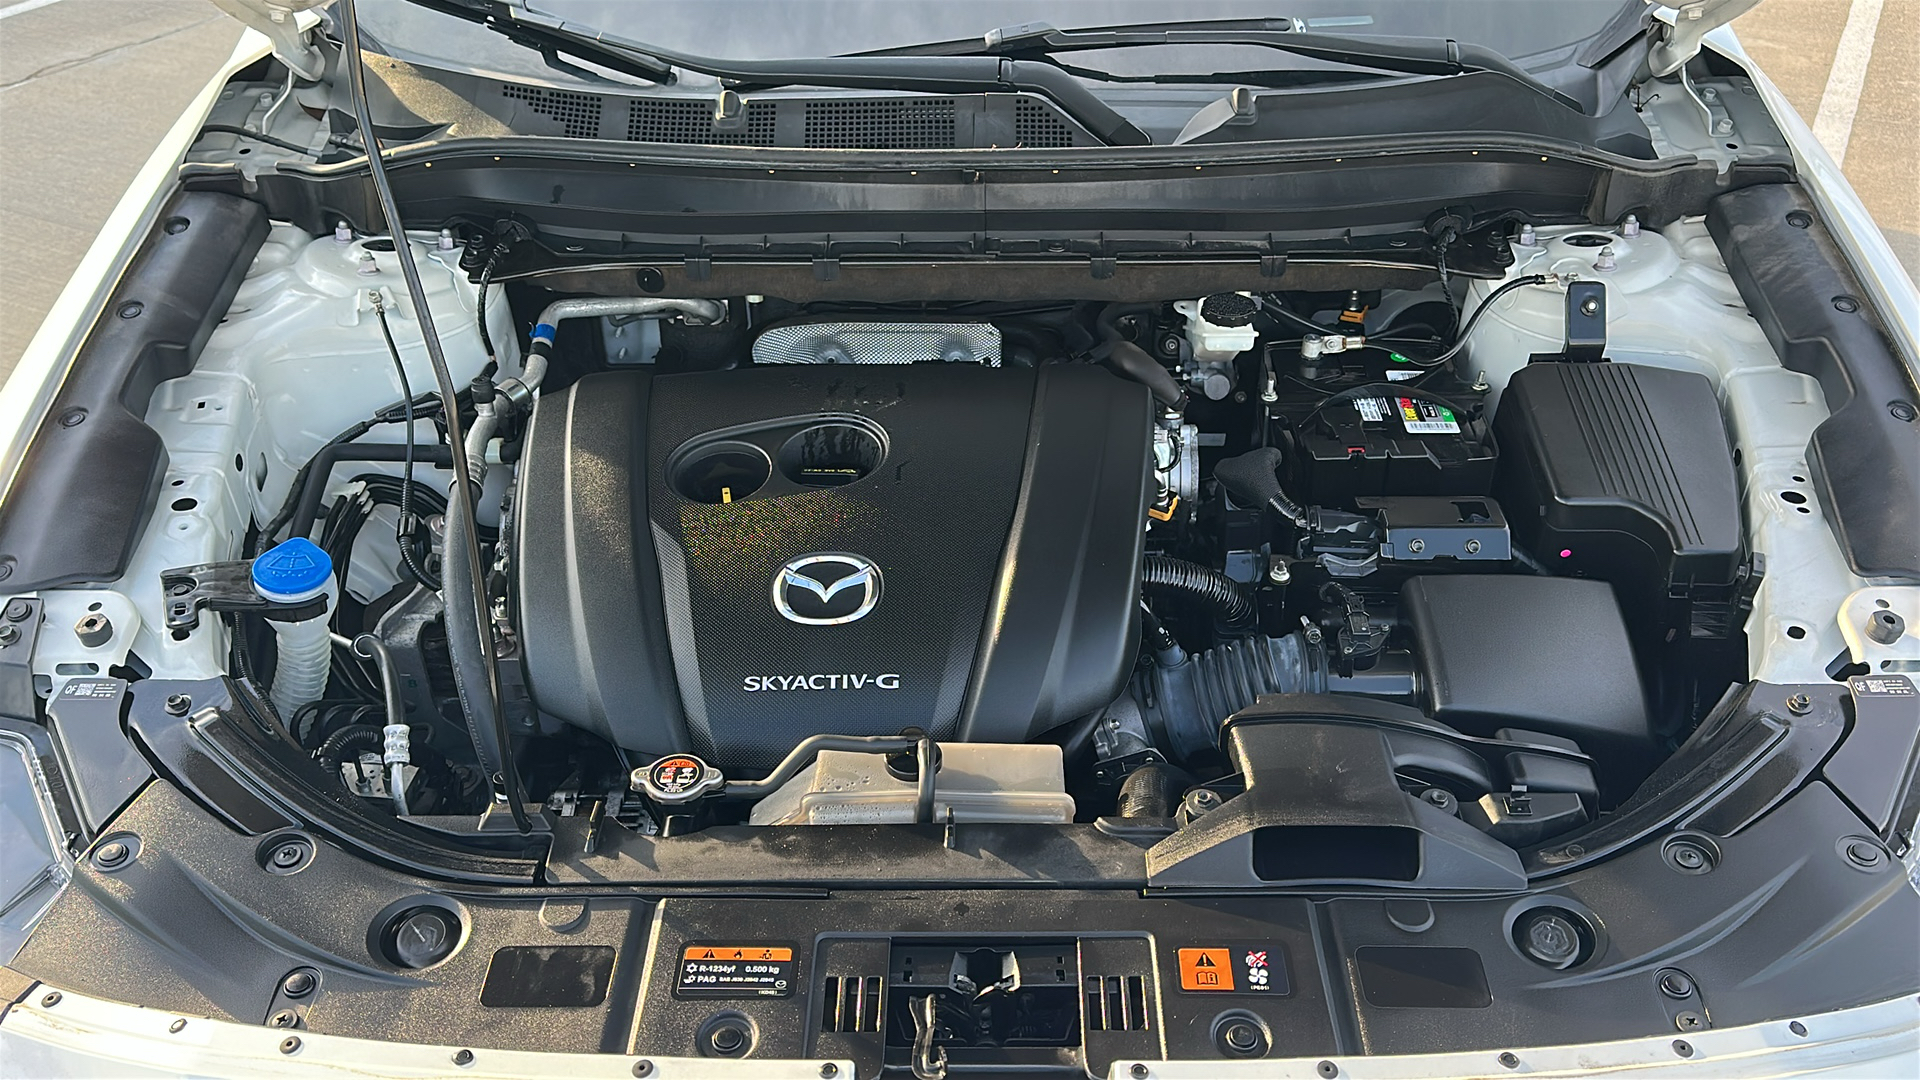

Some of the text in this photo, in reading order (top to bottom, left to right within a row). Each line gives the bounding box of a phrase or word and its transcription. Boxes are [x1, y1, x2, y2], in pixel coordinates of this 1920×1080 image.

[743, 673, 900, 692] SKYACTIV-G
[699, 965, 736, 974] R-1234yf
[769, 966, 780, 974] kg
